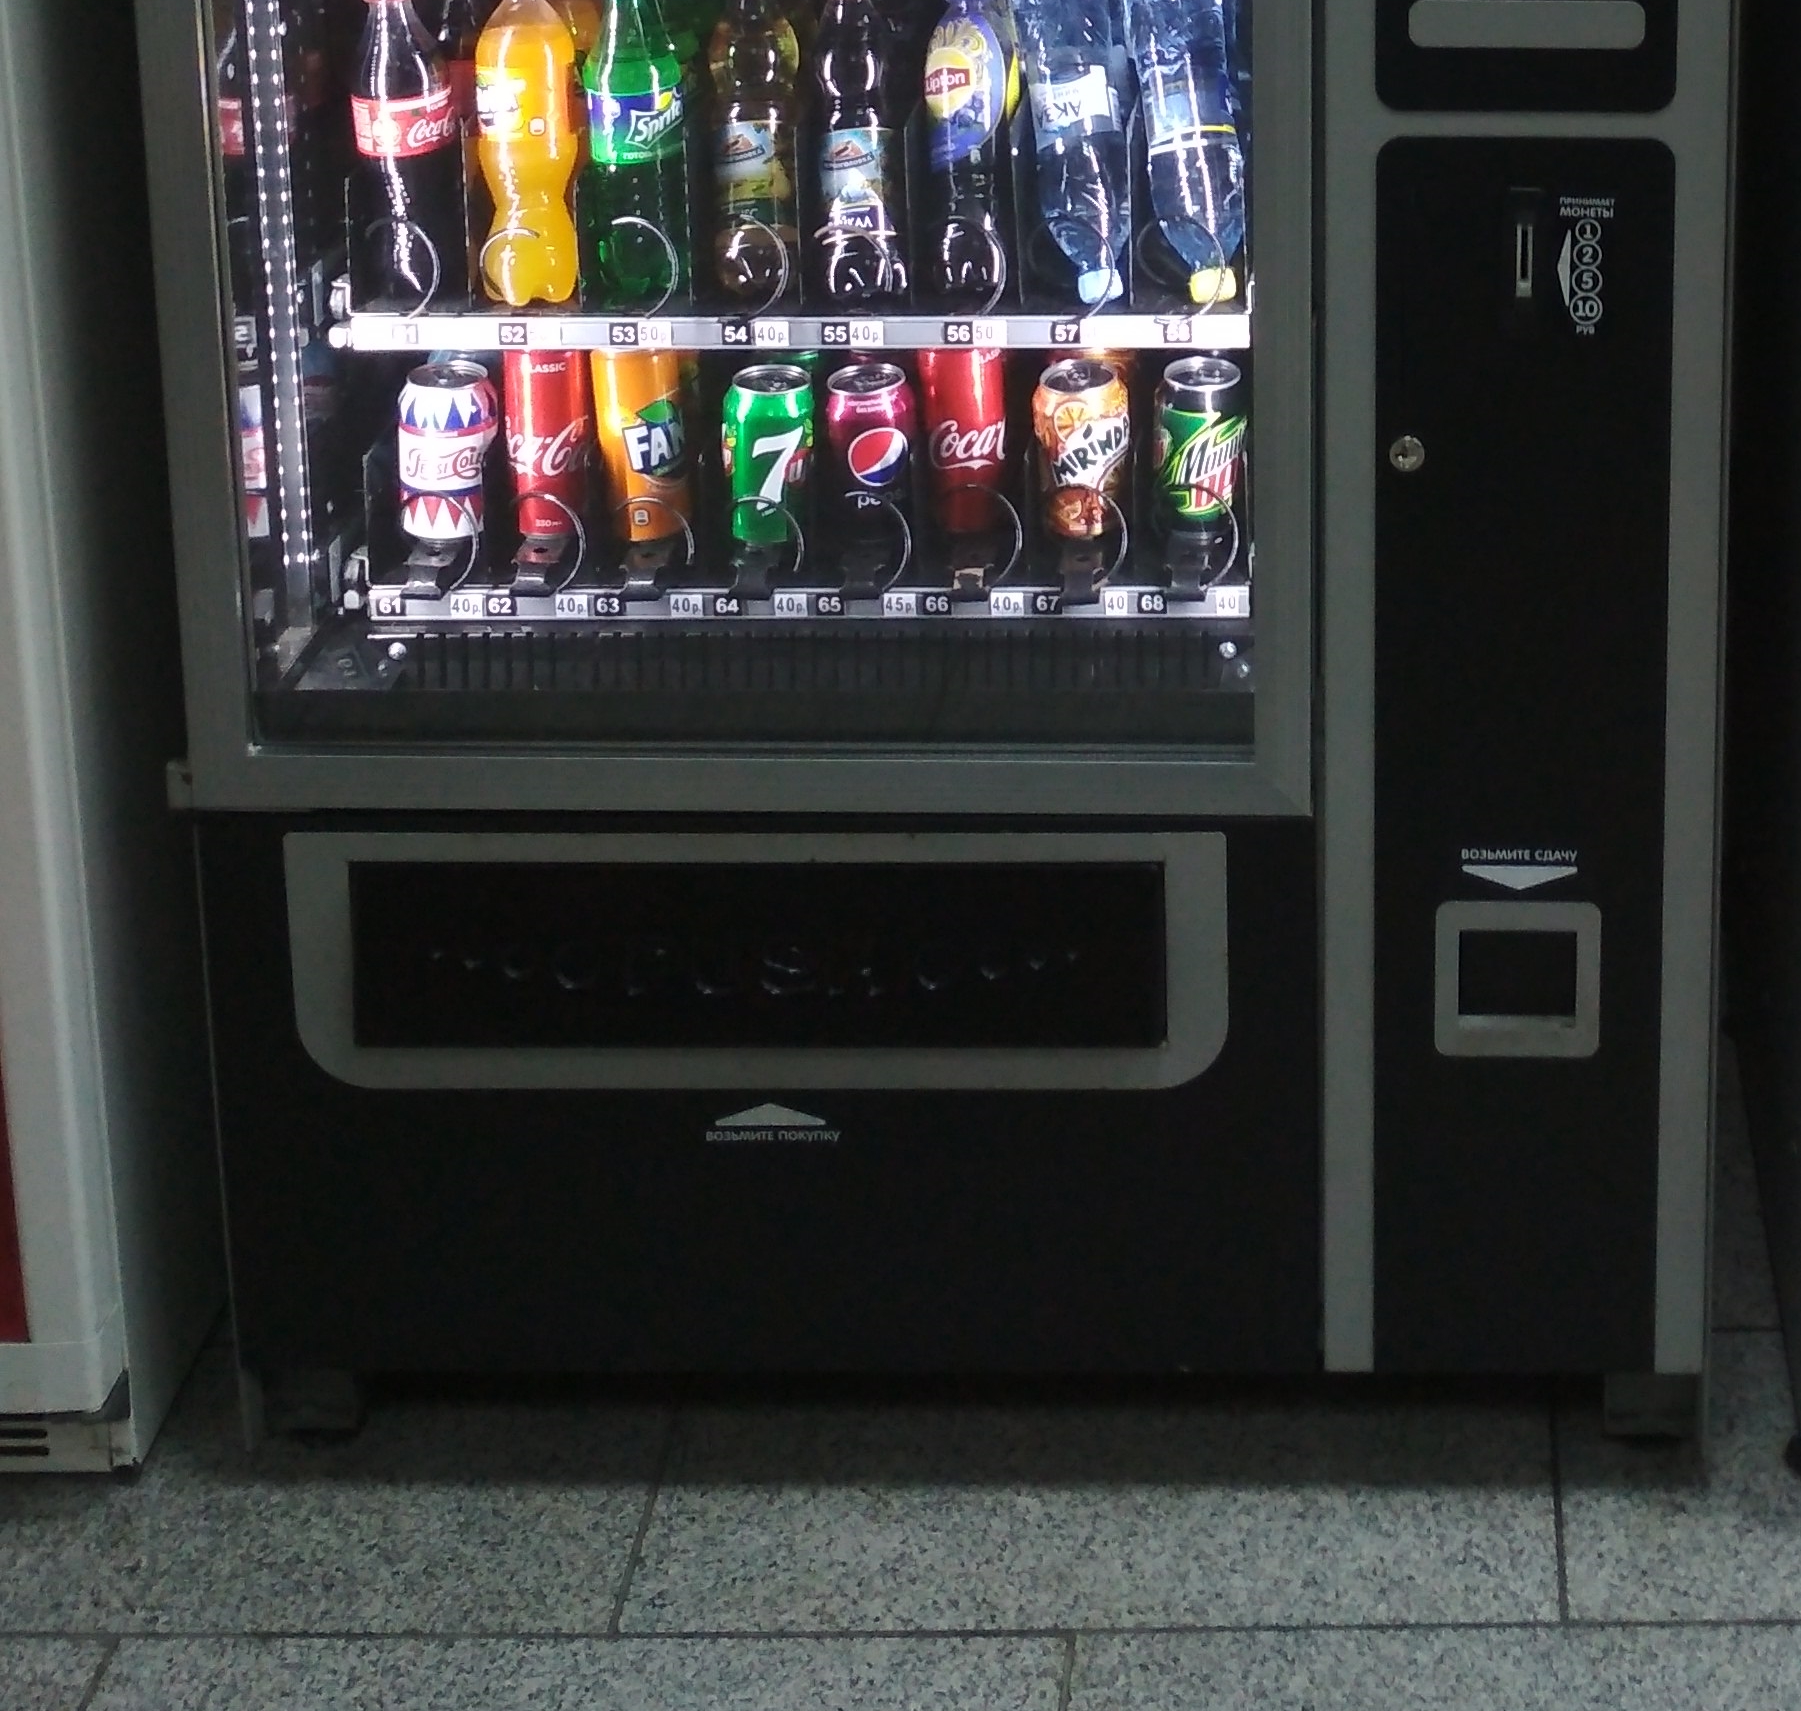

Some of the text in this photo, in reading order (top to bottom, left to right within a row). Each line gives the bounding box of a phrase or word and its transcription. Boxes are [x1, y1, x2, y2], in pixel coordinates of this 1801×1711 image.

[925, 69, 967, 96] Lipton
[406, 110, 450, 149] Coca
[634, 101, 684, 142] Sprite
[1559, 196, 1616, 207] ПРИНИМАЕТ
[1559, 206, 1615, 219] МОНЕТЫ
[1583, 224, 1593, 239] 1
[1581, 246, 1594, 264] 2
[1581, 272, 1594, 290] 5
[1575, 299, 1599, 318] 10
[501, 325, 526, 343] 52
[612, 326, 635, 344] 53
[723, 325, 748, 343] 54
[823, 325, 848, 343] 55
[947, 325, 971, 343] 56
[1054, 325, 1079, 343] 57
[1575, 325, 1596, 336] РУБ
[623, 423, 686, 471] FAN
[930, 419, 1006, 469] Coca
[1052, 413, 1129, 485] MIRINDA
[379, 597, 402, 614] 61
[488, 597, 513, 614] 62
[597, 597, 620, 614] 63
[715, 597, 740, 614] 64
[818, 595, 842, 613] 65
[925, 595, 950, 613] 66
[1036, 595, 1060, 613] 67
[1141, 595, 1165, 613] 68
[1460, 848, 1578, 863] ВОЗЬМИТЕ СДАЧУ
[705, 1130, 842, 1143] ВОЗЬМИТЕ ПОКУПКУ
